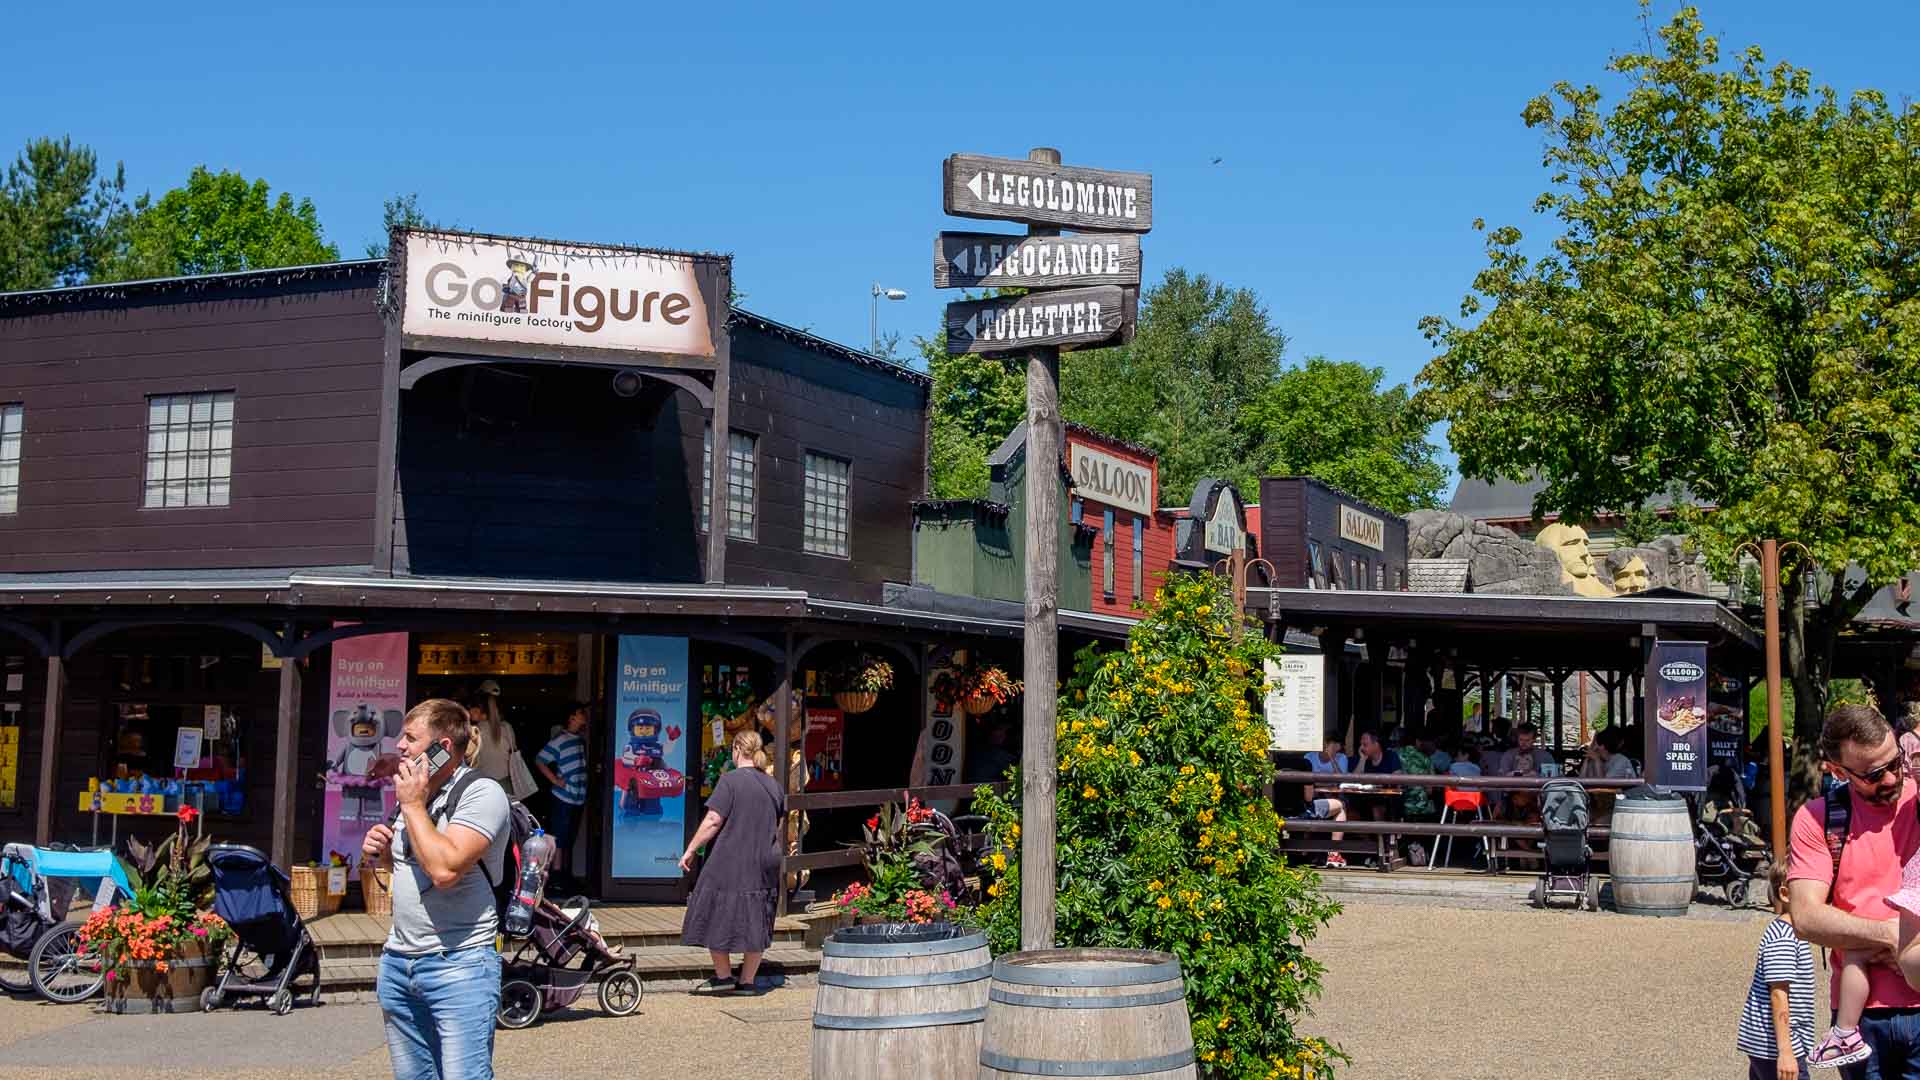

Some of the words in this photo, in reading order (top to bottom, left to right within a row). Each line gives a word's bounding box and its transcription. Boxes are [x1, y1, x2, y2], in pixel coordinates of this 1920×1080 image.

[987, 172, 1136, 218] LEGOLDMINE
[974, 244, 1120, 276] LEGOCANOE
[425, 262, 501, 310] Go
[529, 272, 691, 333] Figure
[428, 308, 451, 319] The
[457, 311, 521, 326] minifigure
[527, 316, 572, 331] factory
[982, 302, 1102, 340] TOILETTER
[1080, 456, 1146, 506] SALOON
[1217, 524, 1236, 548] BAR
[1346, 512, 1380, 544] SALOON
[338, 658, 364, 673] Byg
[623, 664, 648, 678] Byg
[1666, 668, 1697, 676] SALOON
[336, 675, 400, 689] Minifigur
[623, 680, 682, 694] Minifigur
[1665, 751, 1698, 761] SPARE-
[1672, 742, 1691, 752] BBQ
[1671, 762, 1693, 771] RIBS
